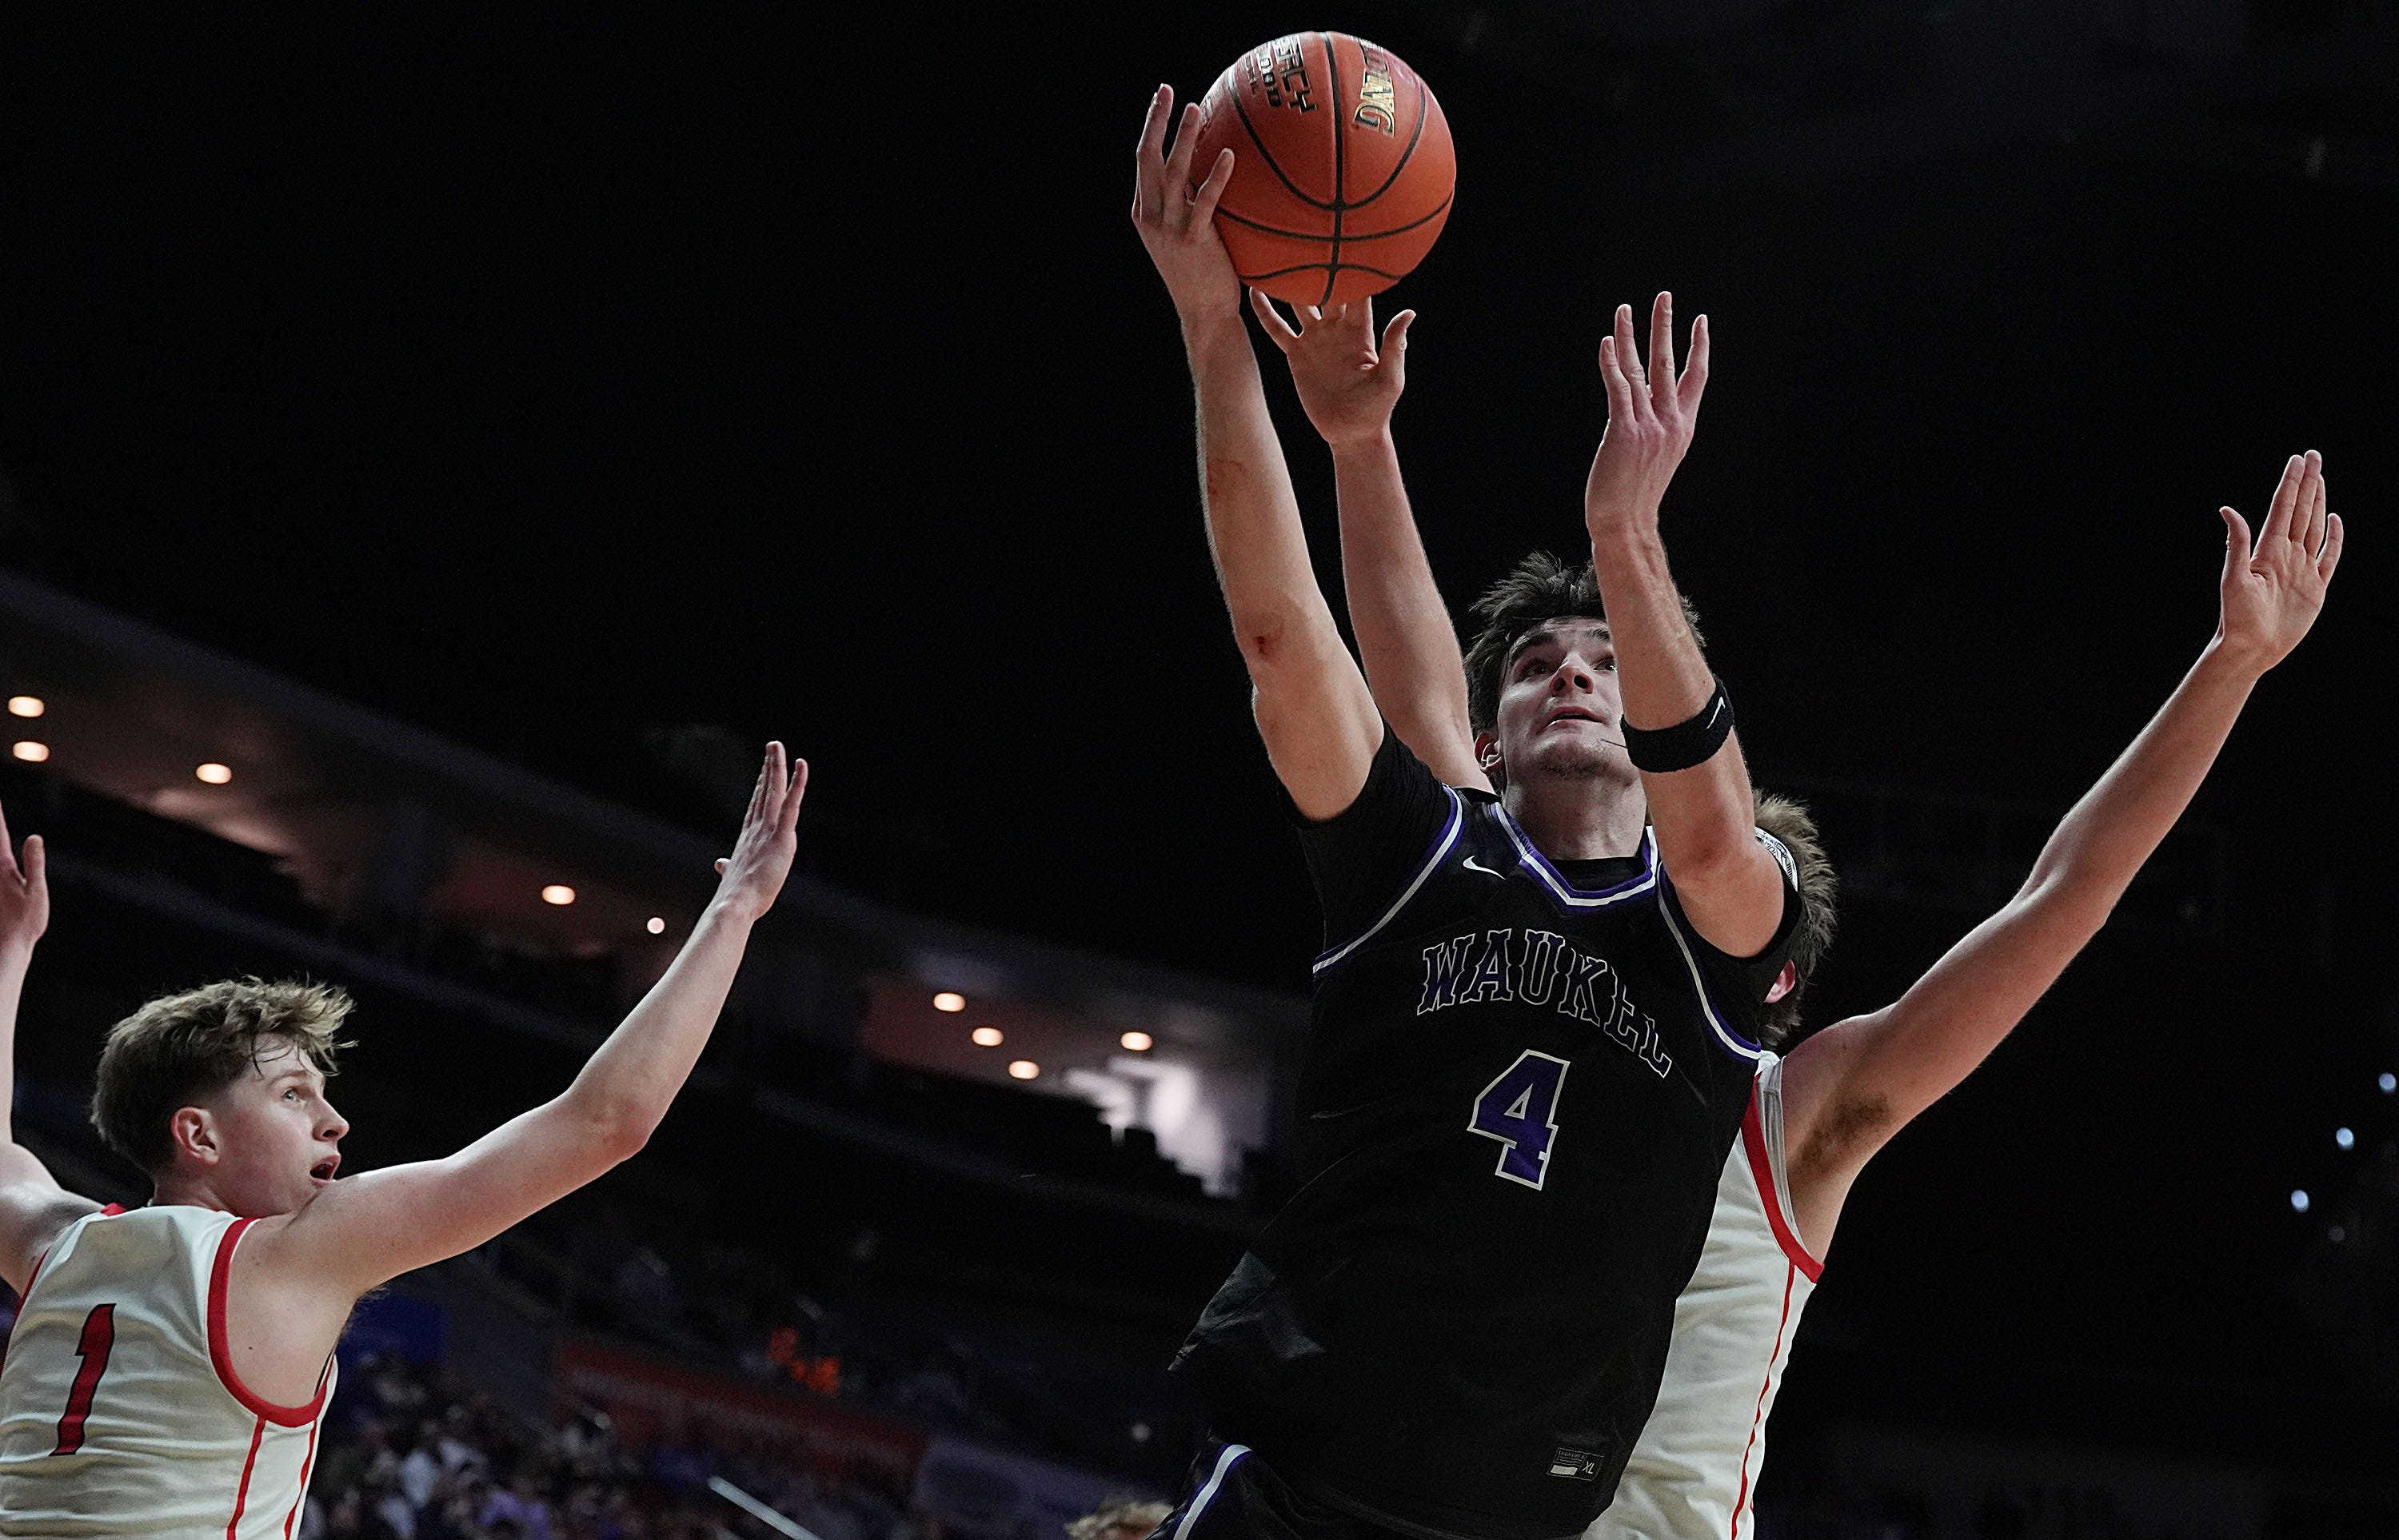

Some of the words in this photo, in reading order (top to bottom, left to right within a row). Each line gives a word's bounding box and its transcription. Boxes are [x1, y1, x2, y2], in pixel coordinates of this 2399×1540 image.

[1466, 1048, 1571, 1191] 4
[48, 1303, 117, 1457] 1
[1581, 1460, 1595, 1474] XL
